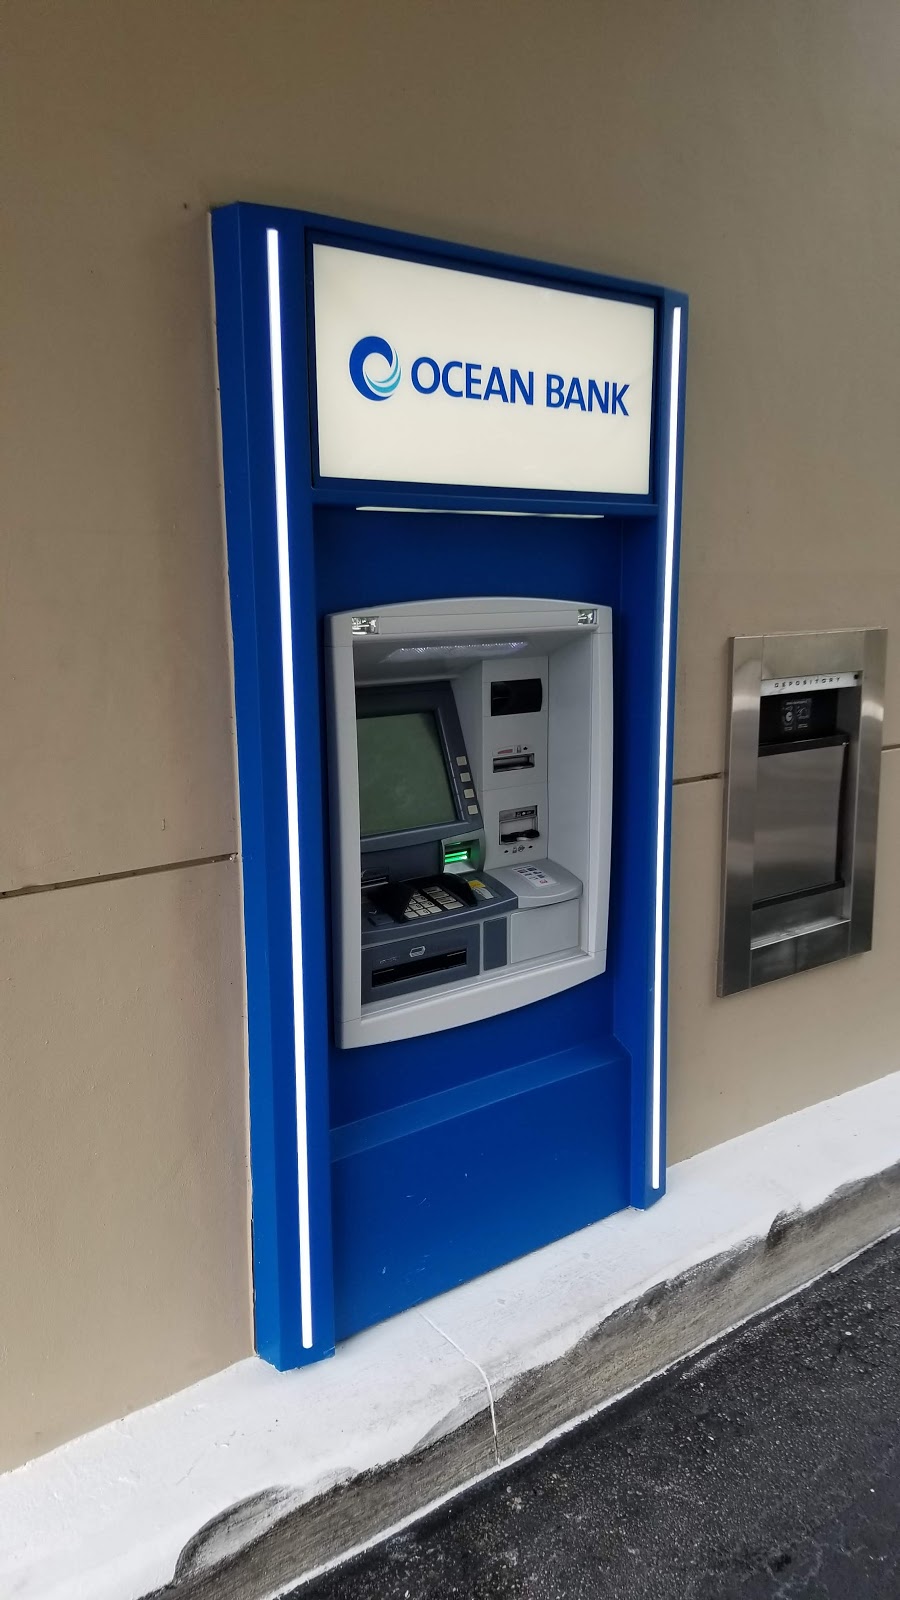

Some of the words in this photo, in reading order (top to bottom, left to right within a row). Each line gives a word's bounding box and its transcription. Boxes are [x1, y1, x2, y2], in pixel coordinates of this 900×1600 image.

[411, 356, 534, 406] OCEAN
[546, 373, 630, 417] BANK
[774, 676, 840, 688] DEPOSITORY
